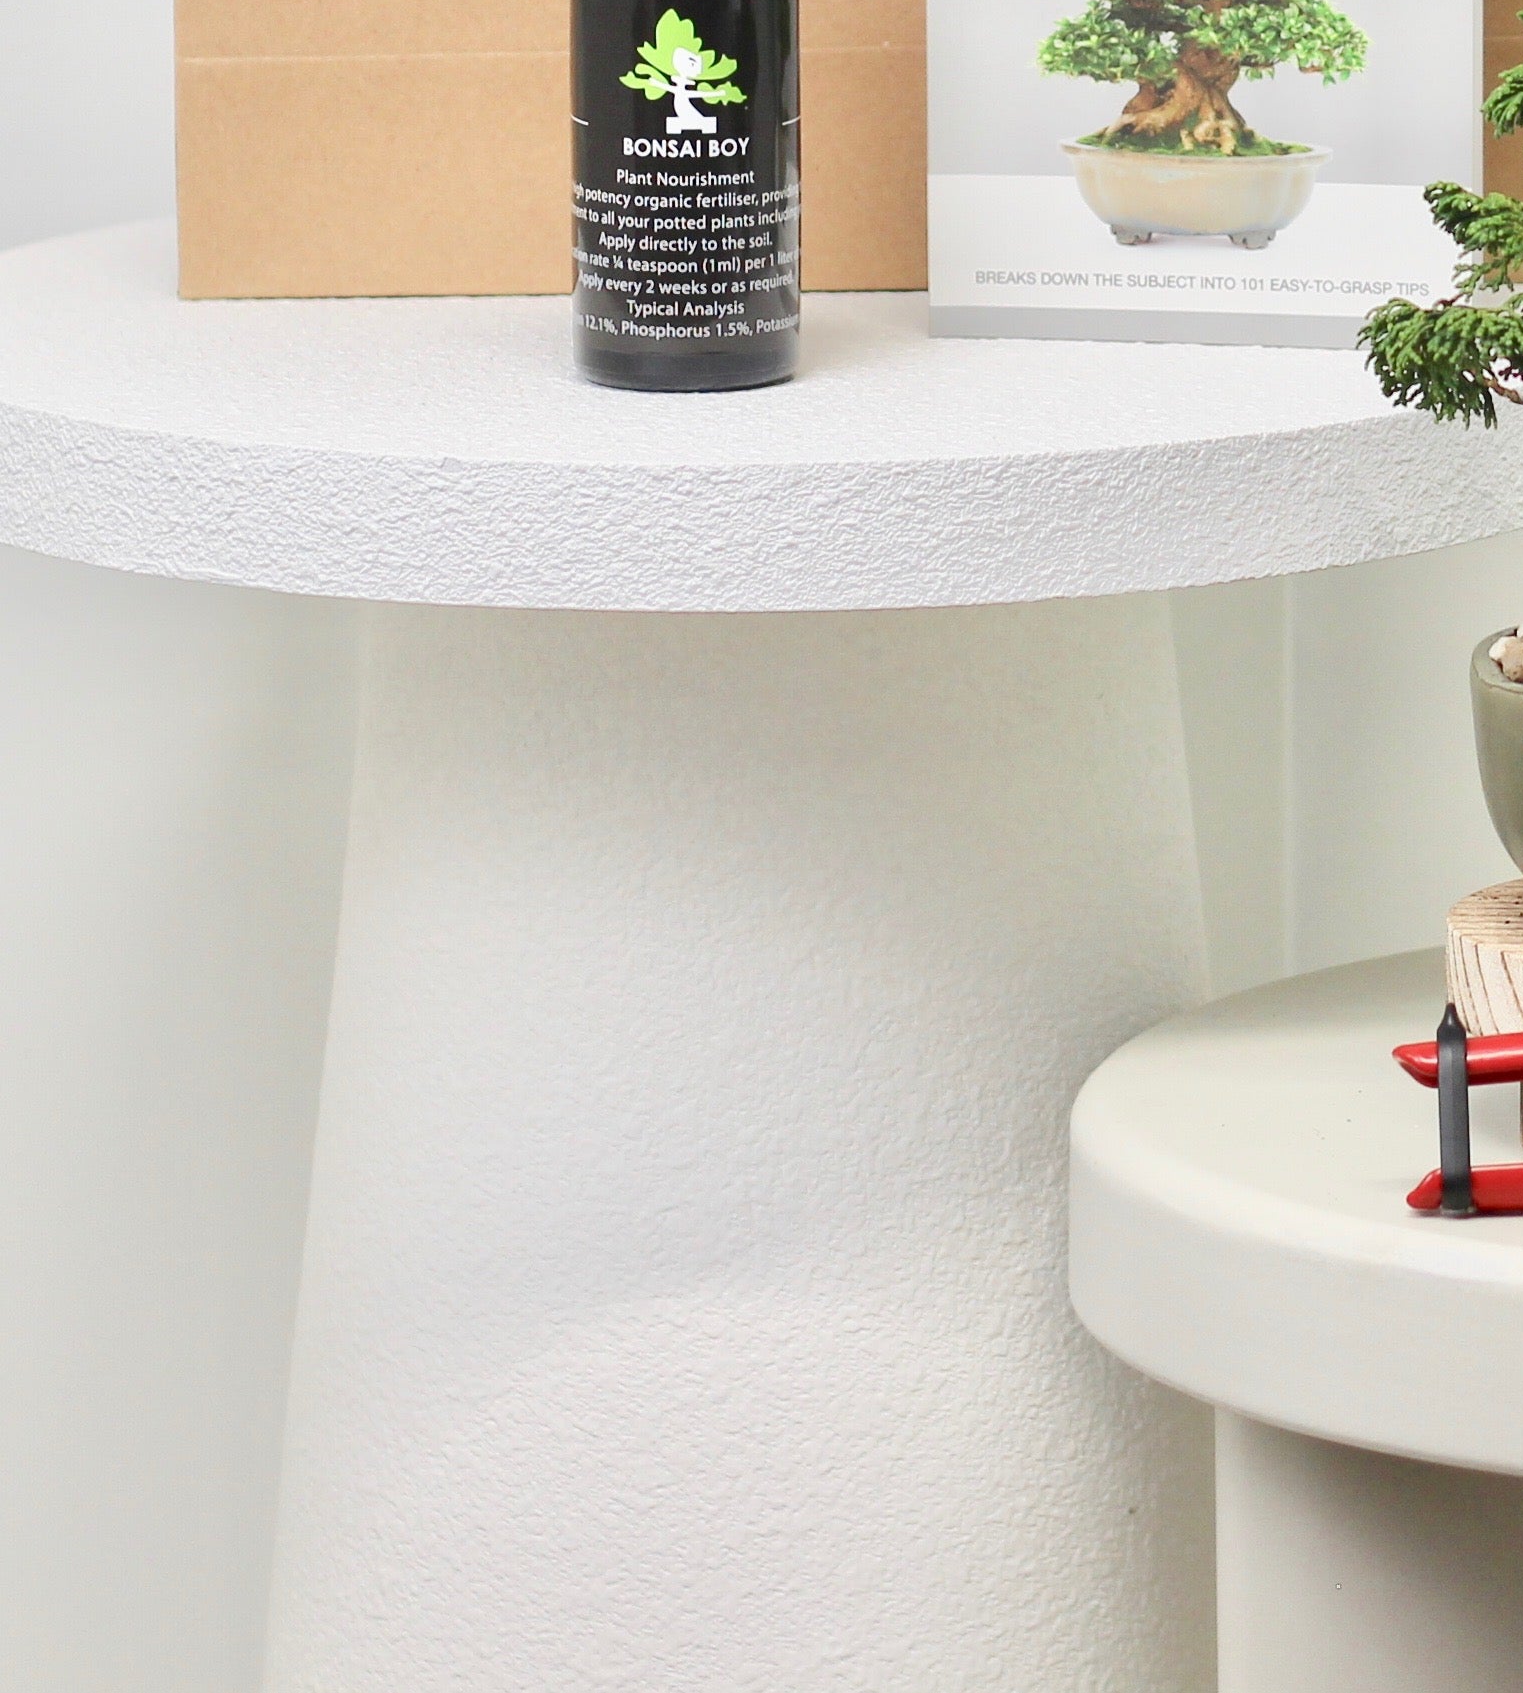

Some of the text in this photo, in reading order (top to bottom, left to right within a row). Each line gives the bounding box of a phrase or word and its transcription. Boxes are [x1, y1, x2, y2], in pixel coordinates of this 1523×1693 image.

[622, 137, 750, 158] BONSAI BOY
[616, 169, 755, 187] Plant Nourishment
[585, 188, 631, 209] potency
[634, 193, 692, 211] organic
[696, 192, 759, 208] fertiliser,
[588, 209, 600, 222] to
[601, 210, 615, 226] all
[617, 216, 650, 230] your
[653, 215, 706, 232] potted
[711, 214, 755, 232] plants
[598, 231, 773, 255] Apply directly to the soil.
[589, 253, 610, 268] rate
[627, 257, 698, 275] teaspoon
[702, 256, 741, 275] (1ml)
[745, 257, 766, 274] per
[578, 269, 604, 291] Apply
[605, 277, 642, 296] every
[645, 280, 655, 294] 2
[658, 280, 707, 295] weeks
[711, 282, 728, 295] or
[731, 281, 746, 294] as
[975, 270, 1430, 296] BREAKS DOWN THE SUBJECT INTO 101 EASY-TO-GRASP TIPS
[626, 299, 745, 319] Typical Analysis
[621, 320, 711, 340] Phosphorus
[715, 322, 753, 338] 1.5%,
